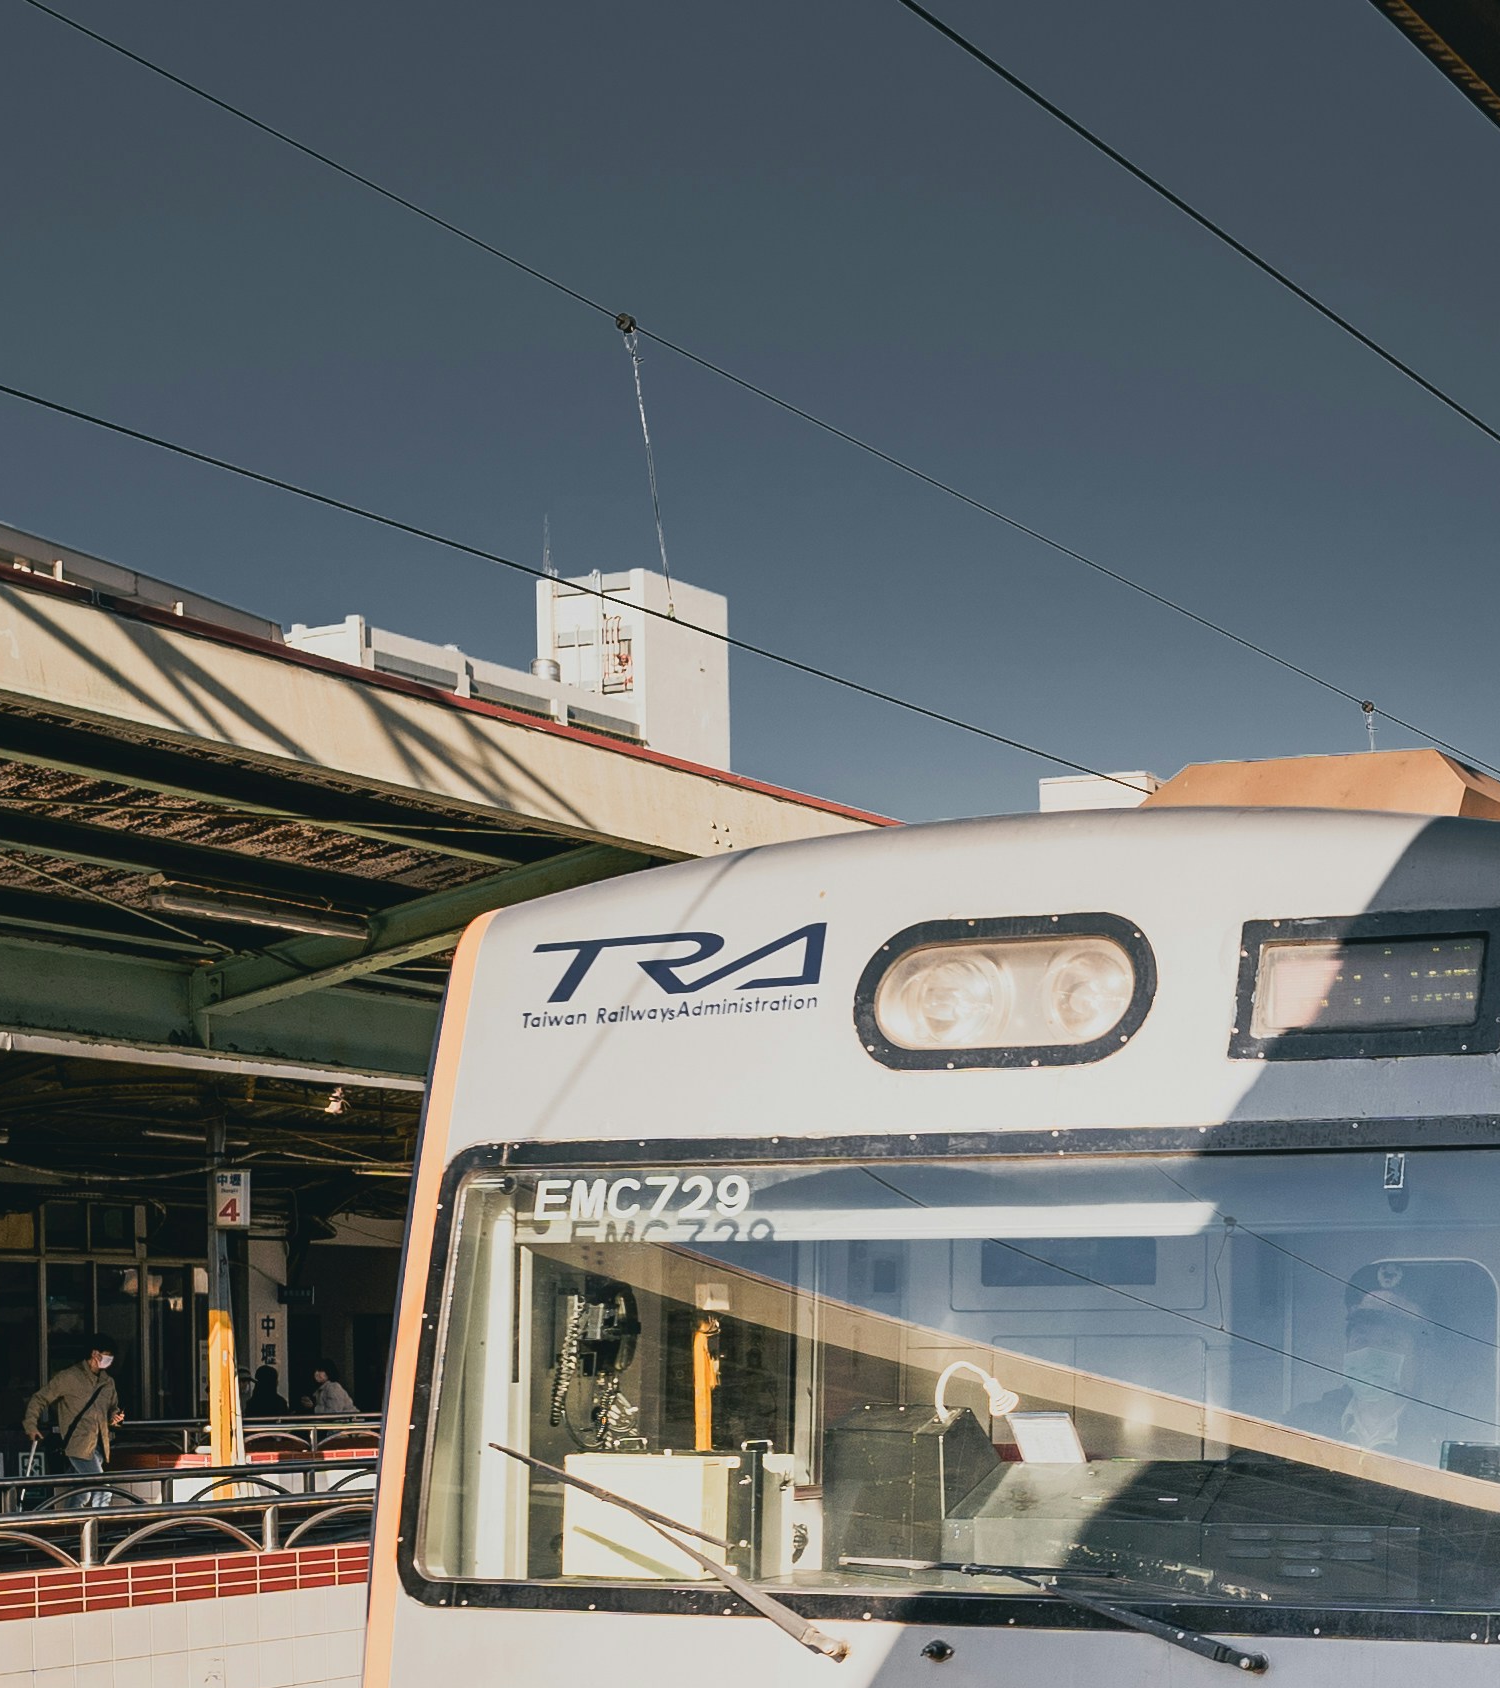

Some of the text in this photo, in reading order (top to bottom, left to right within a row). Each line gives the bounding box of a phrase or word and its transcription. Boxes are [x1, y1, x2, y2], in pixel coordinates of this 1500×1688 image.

[533, 922, 827, 1003] TRA
[522, 1011, 587, 1028] Taiwan
[219, 1198, 240, 1222] 4
[534, 1174, 750, 1221] EMC729
[261, 1315, 277, 1365] 中壢
